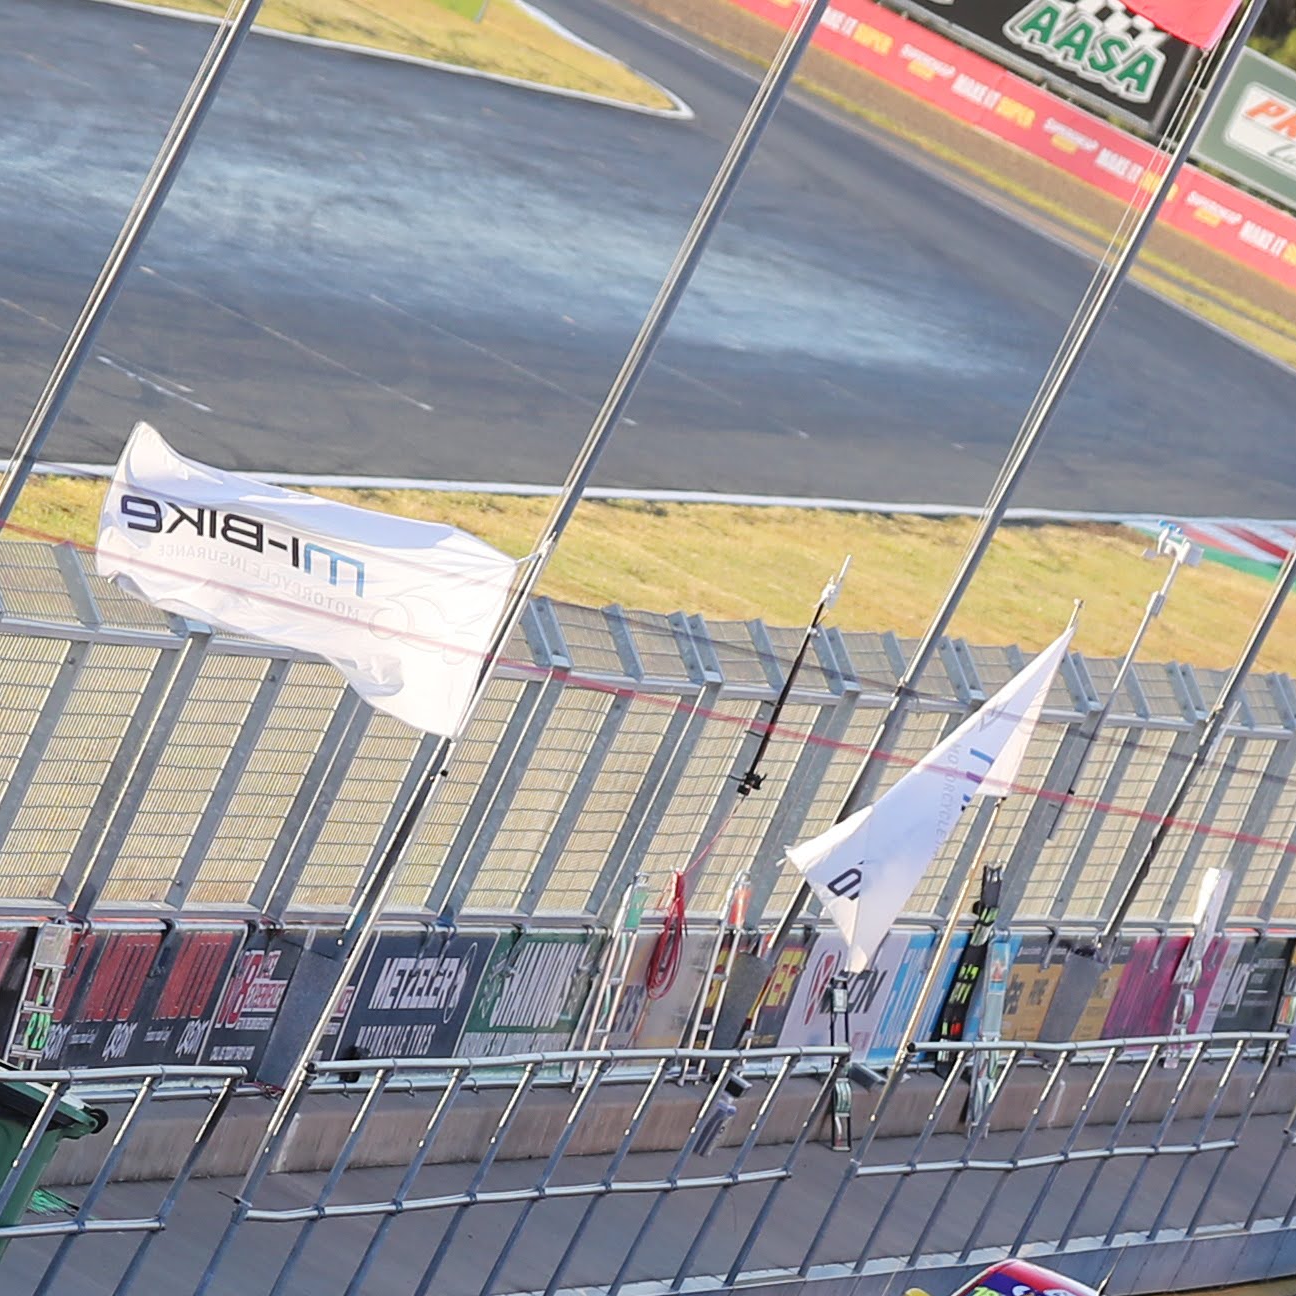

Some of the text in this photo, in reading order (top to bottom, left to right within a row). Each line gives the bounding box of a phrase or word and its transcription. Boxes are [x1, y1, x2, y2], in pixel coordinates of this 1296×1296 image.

[1022, 2, 1163, 97] AASA
[367, 956, 463, 1010] METZELER
[489, 942, 586, 1029] SHANNONS
